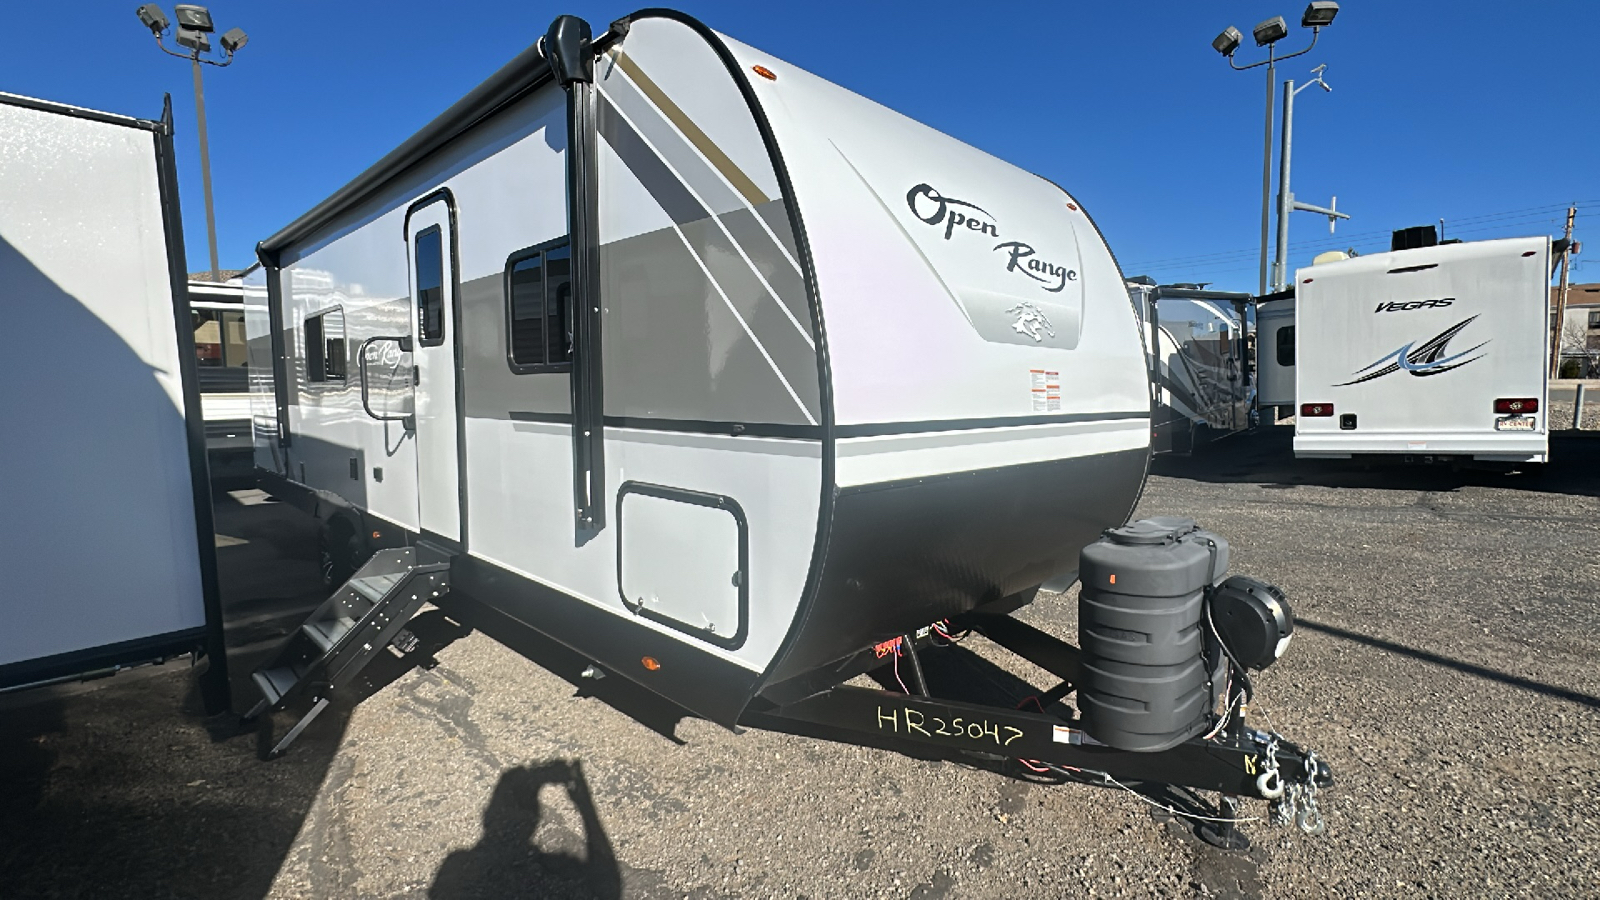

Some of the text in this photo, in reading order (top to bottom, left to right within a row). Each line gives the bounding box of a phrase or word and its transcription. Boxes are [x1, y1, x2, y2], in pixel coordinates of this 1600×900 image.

[906, 183, 1077, 292] Open Range
[1374, 297, 1456, 313] VEGAS
[877, 706, 1024, 746] HR25047
